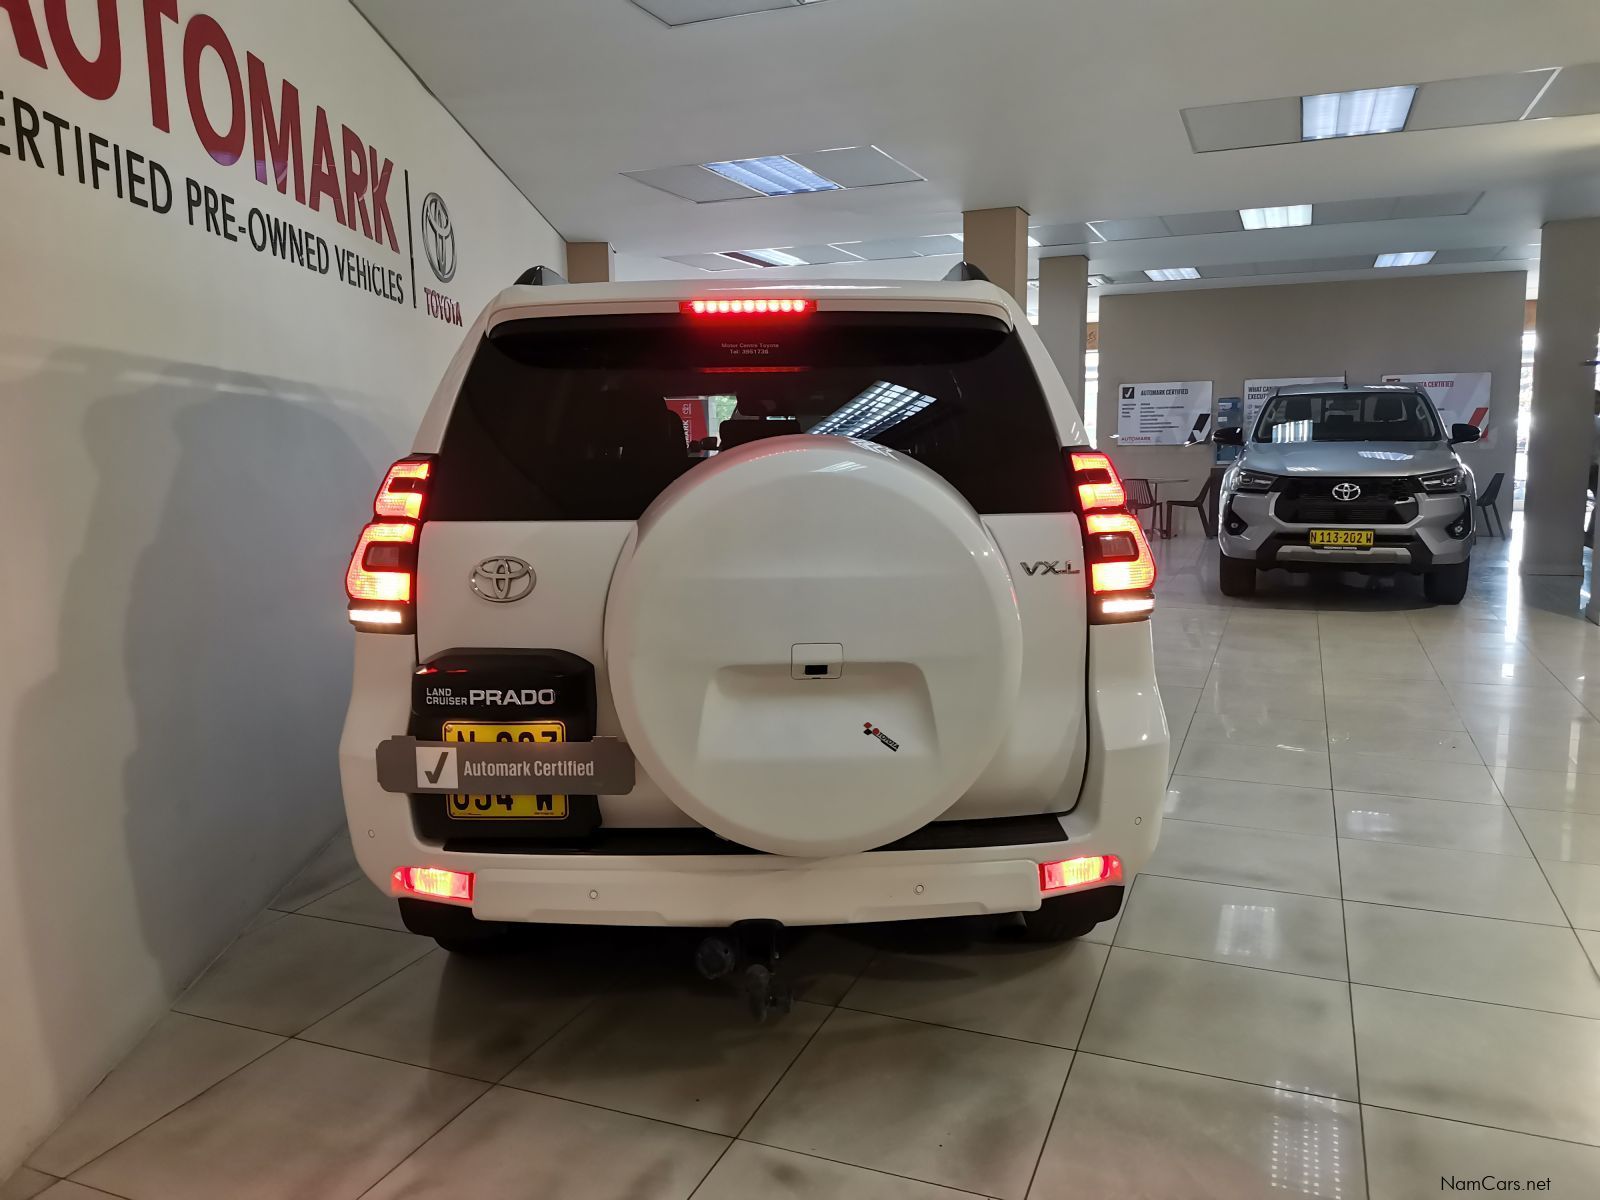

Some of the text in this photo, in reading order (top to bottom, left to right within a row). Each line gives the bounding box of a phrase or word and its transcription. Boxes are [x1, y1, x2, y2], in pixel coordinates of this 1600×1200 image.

[0, 0, 400, 254] UTOMARK
[186, 177, 330, 275] PRE-OWNED
[335, 244, 404, 304] VEHICLES
[423, 287, 463, 327] TOYOTA
[1310, 532, 1372, 544] N 113-202 W
[426, 687, 452, 697] LAND
[426, 688, 556, 706] CRUISER PRADO
[463, 760, 595, 777] Automark Certified
